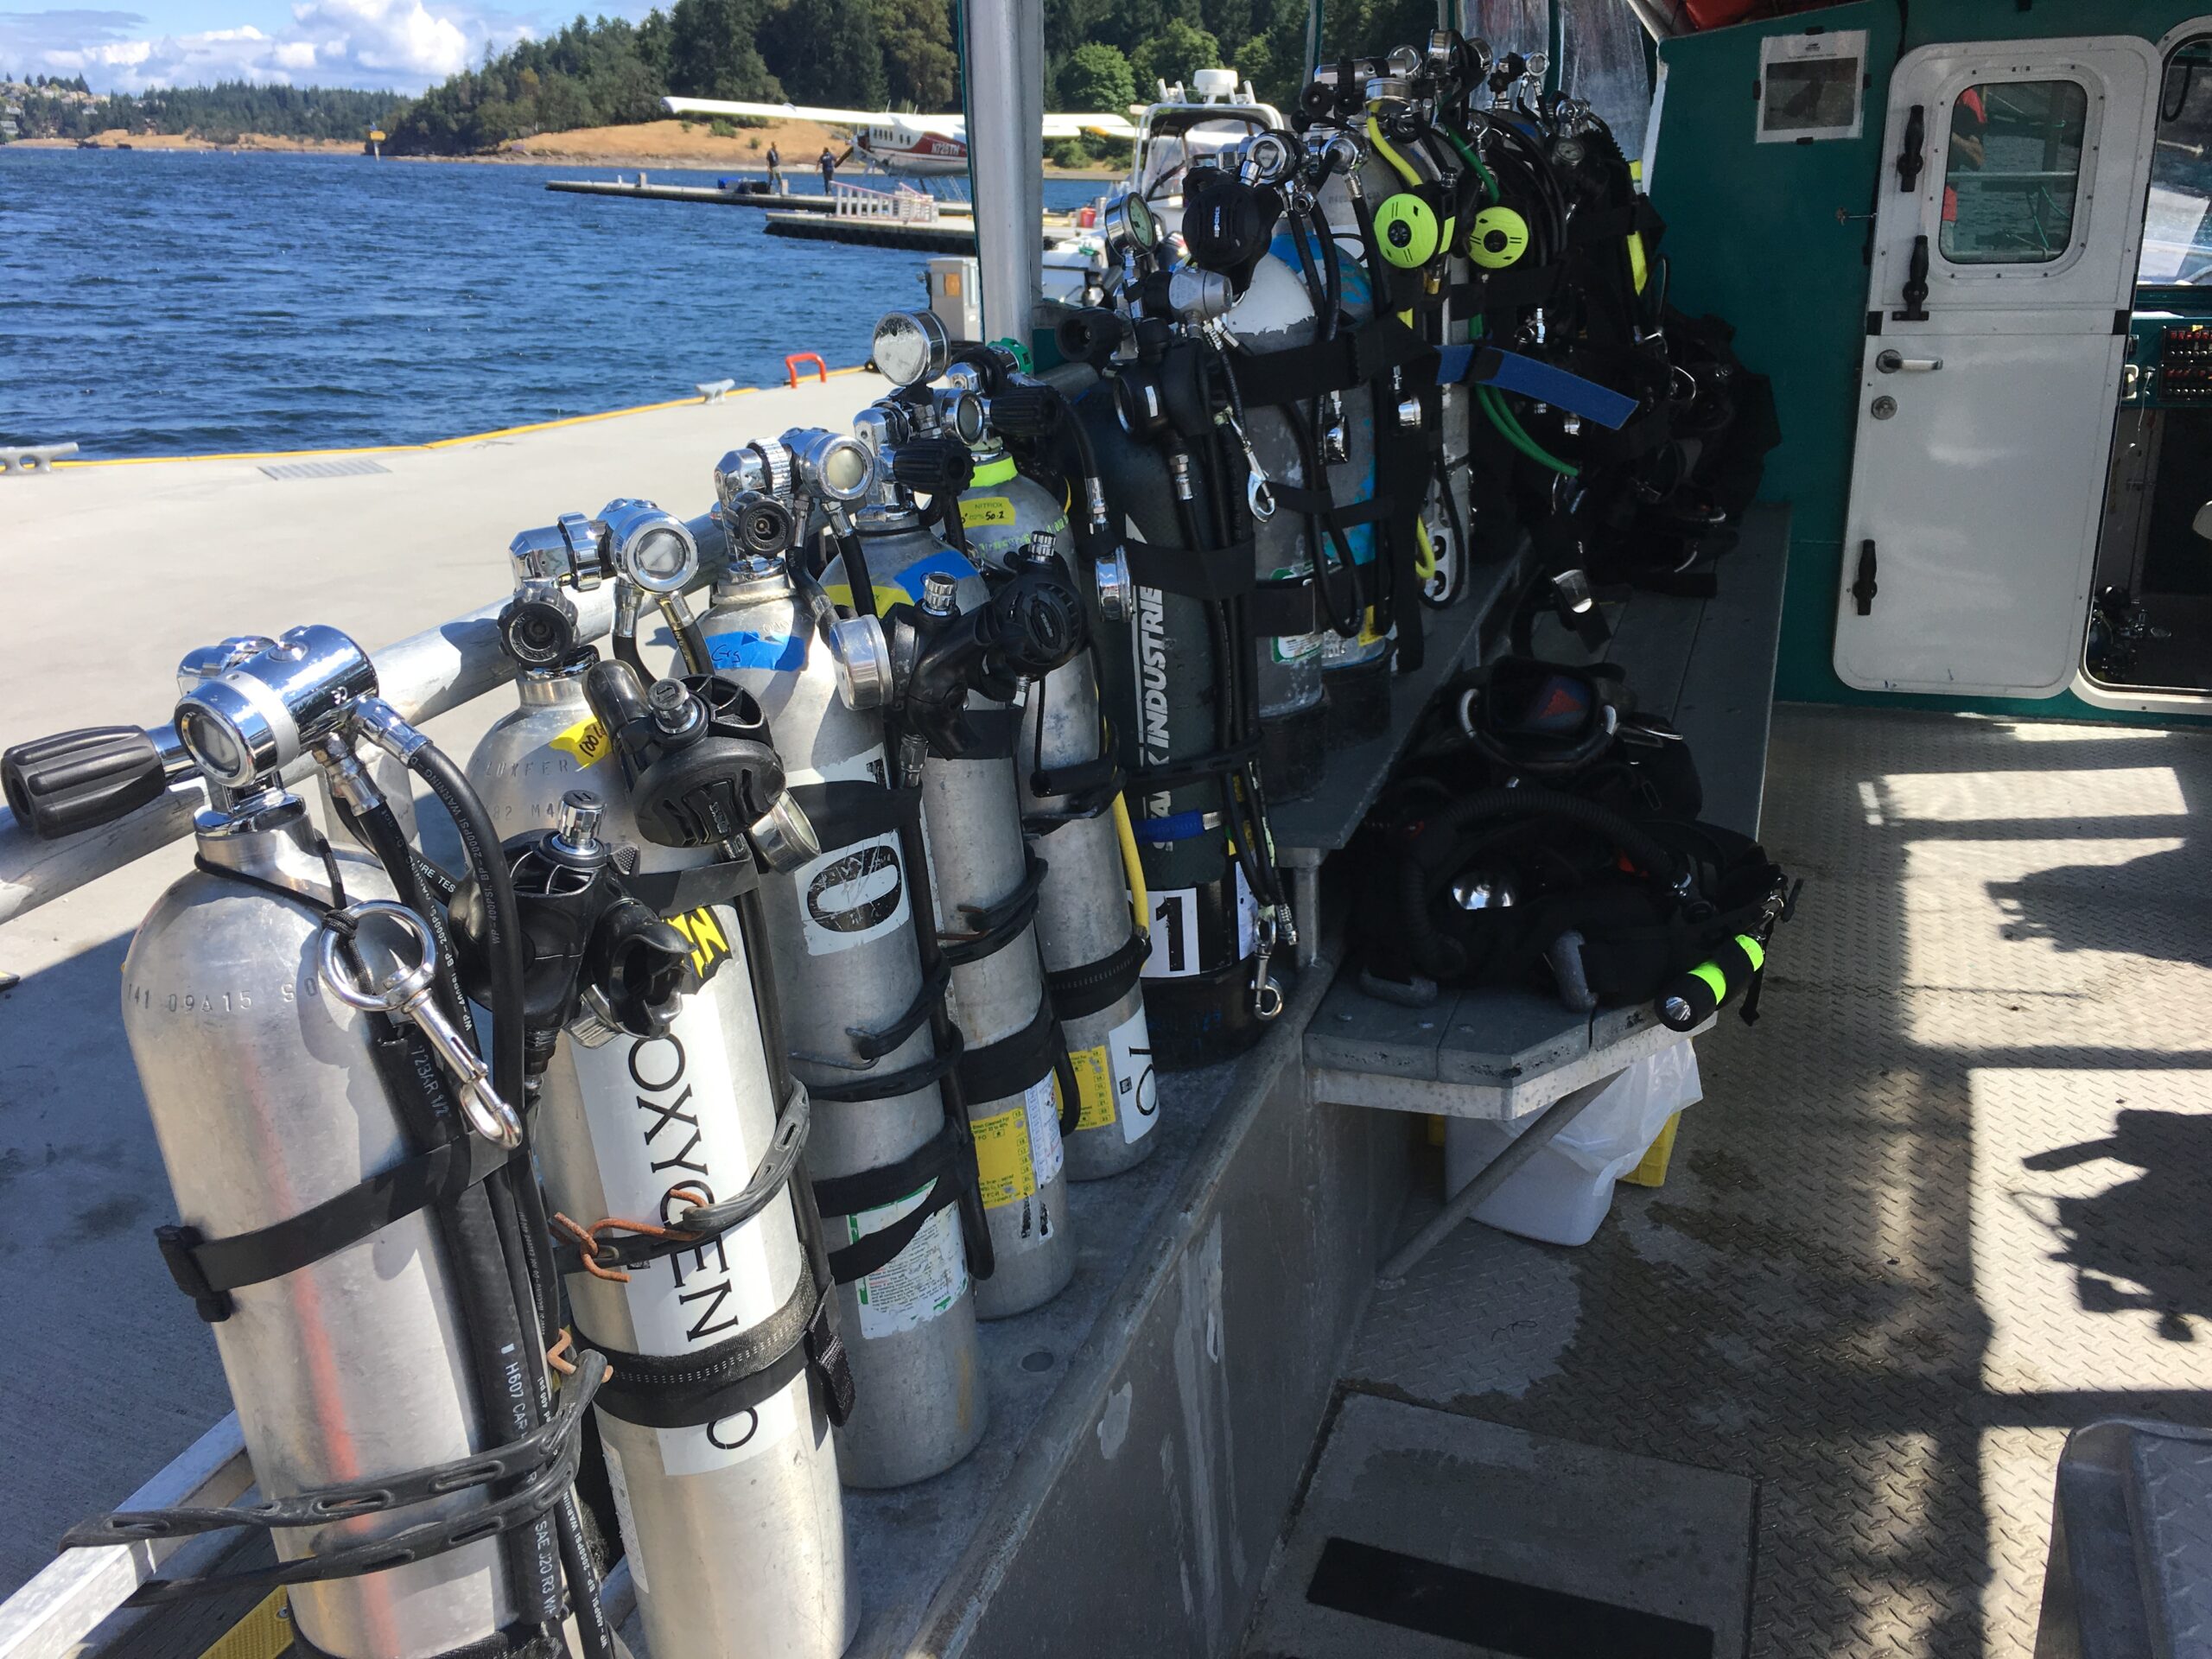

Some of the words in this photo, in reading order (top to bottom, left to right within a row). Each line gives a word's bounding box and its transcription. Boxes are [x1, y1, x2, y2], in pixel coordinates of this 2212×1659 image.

[1139, 586, 1170, 749] INDUSTRIE
[486, 760, 569, 777] LUXFER
[437, 875, 456, 893] TES
[628, 1033, 739, 1343] OXYGEN
[562, 1491, 578, 1532] WARNIN
[535, 1520, 550, 1551] SAE
